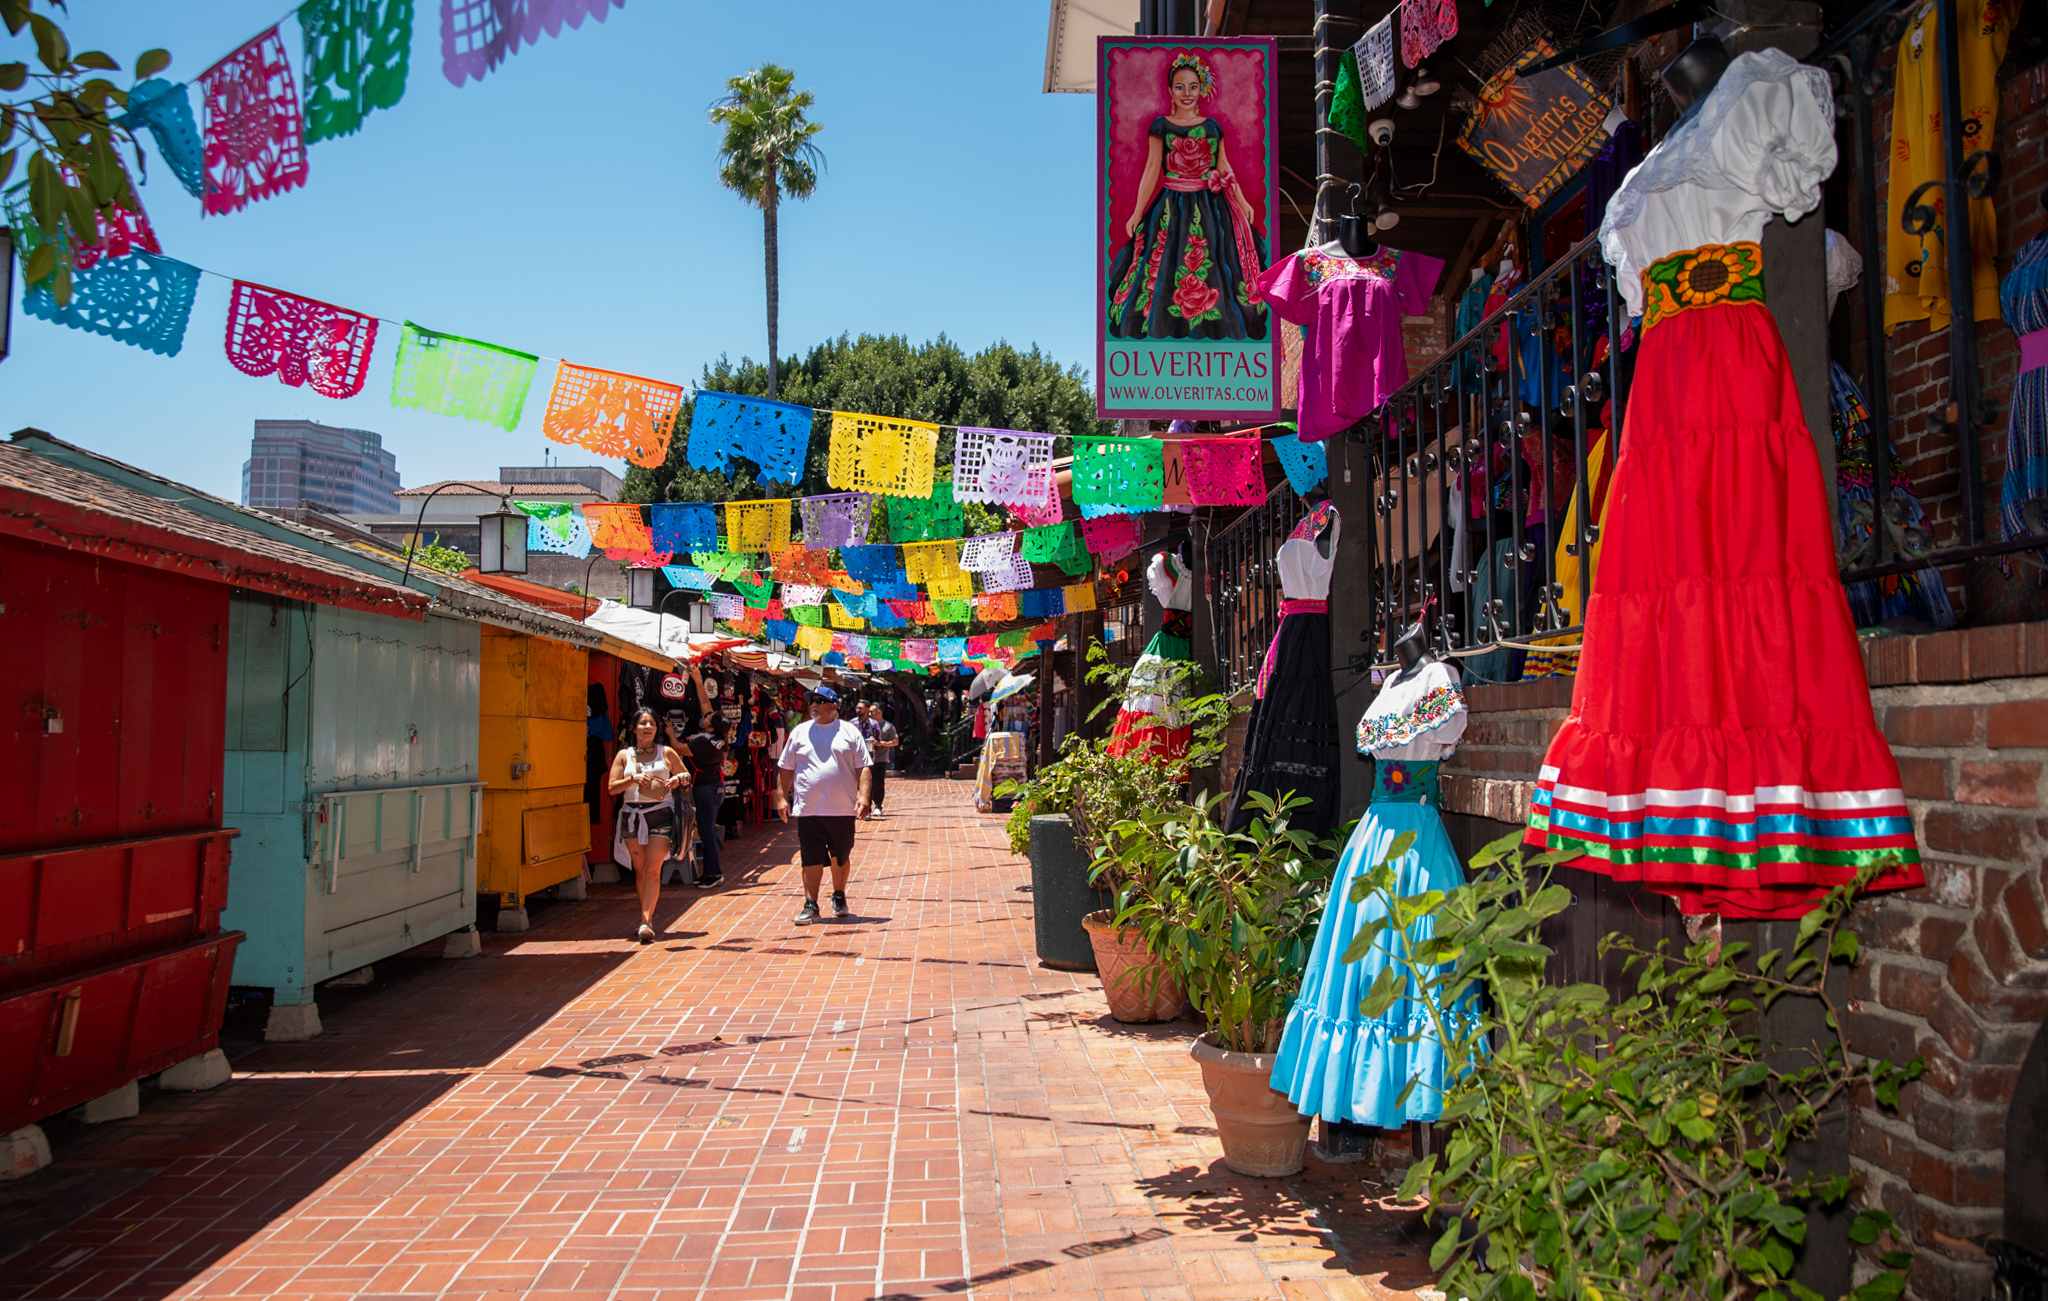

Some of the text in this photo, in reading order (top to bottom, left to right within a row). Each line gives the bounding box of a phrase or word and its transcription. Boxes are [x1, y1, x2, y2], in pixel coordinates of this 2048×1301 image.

[1484, 95, 1578, 172] OLVERITA'S
[1533, 100, 1607, 161] VILLAGE
[1109, 350, 1268, 378] OLVERITAS
[1109, 386, 1269, 402] WWW.OLVERITAS.COM
